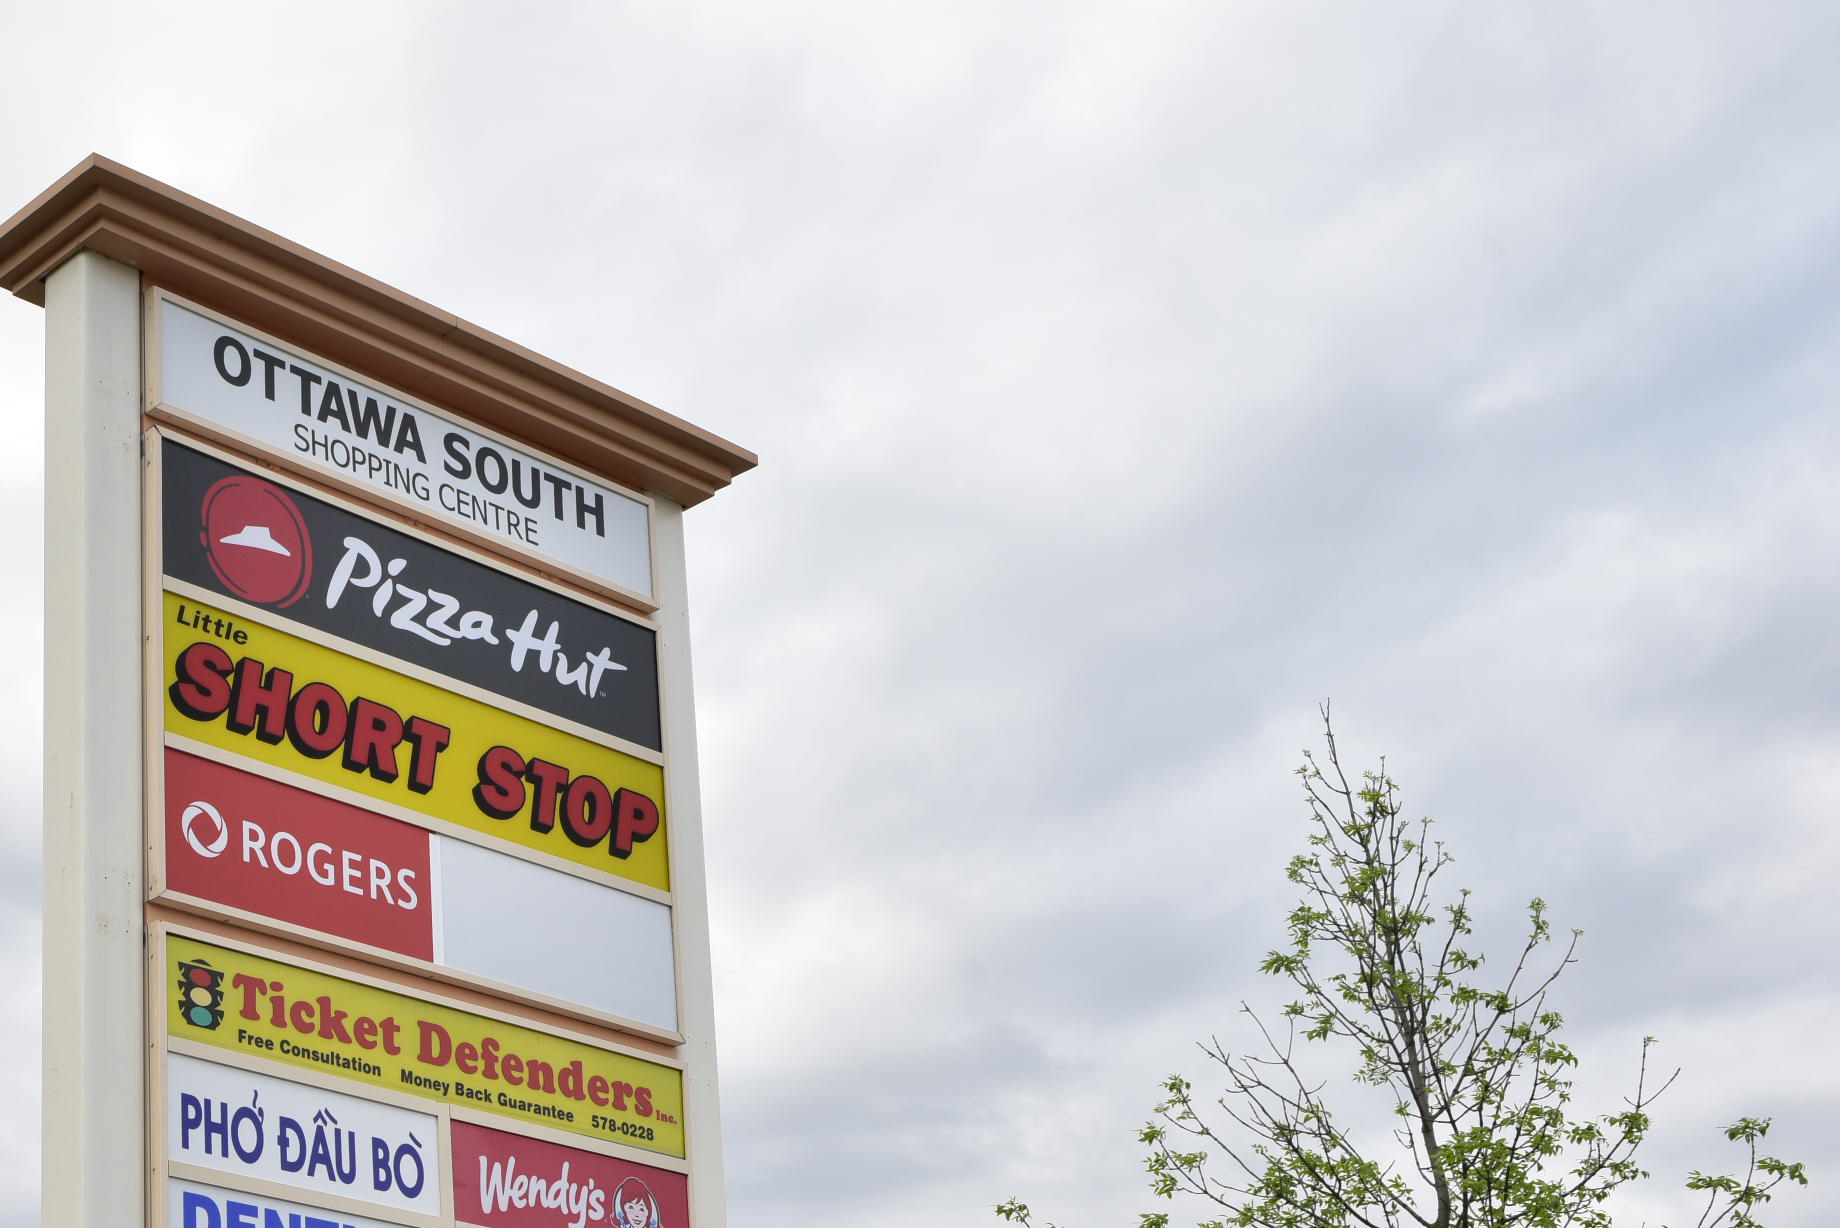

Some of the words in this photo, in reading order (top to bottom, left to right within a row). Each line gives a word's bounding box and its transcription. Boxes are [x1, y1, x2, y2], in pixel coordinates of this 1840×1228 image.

[213, 334, 427, 465] OTTAWA
[442, 431, 606, 537] SOUTH
[292, 423, 431, 502] SHOPPING
[438, 483, 540, 547] CENTRE
[176, 604, 249, 646] Little
[326, 536, 500, 647] Pizza
[505, 609, 628, 699] Hut
[169, 641, 451, 796] SHORT
[472, 745, 660, 859] STOP
[241, 819, 419, 911] ROGERS
[232, 972, 402, 1056] Ticket
[416, 1019, 654, 1118] Defenders
[655, 1109, 678, 1125] Inc.
[238, 1029, 275, 1051] Free
[279, 1039, 382, 1077] Consultation
[400, 1068, 450, 1097] Money
[455, 1082, 492, 1104] Back
[497, 1092, 575, 1123] Guarantee
[591, 1115, 655, 1141] 578-0228
[372, 1131, 424, 1199] BÒ
